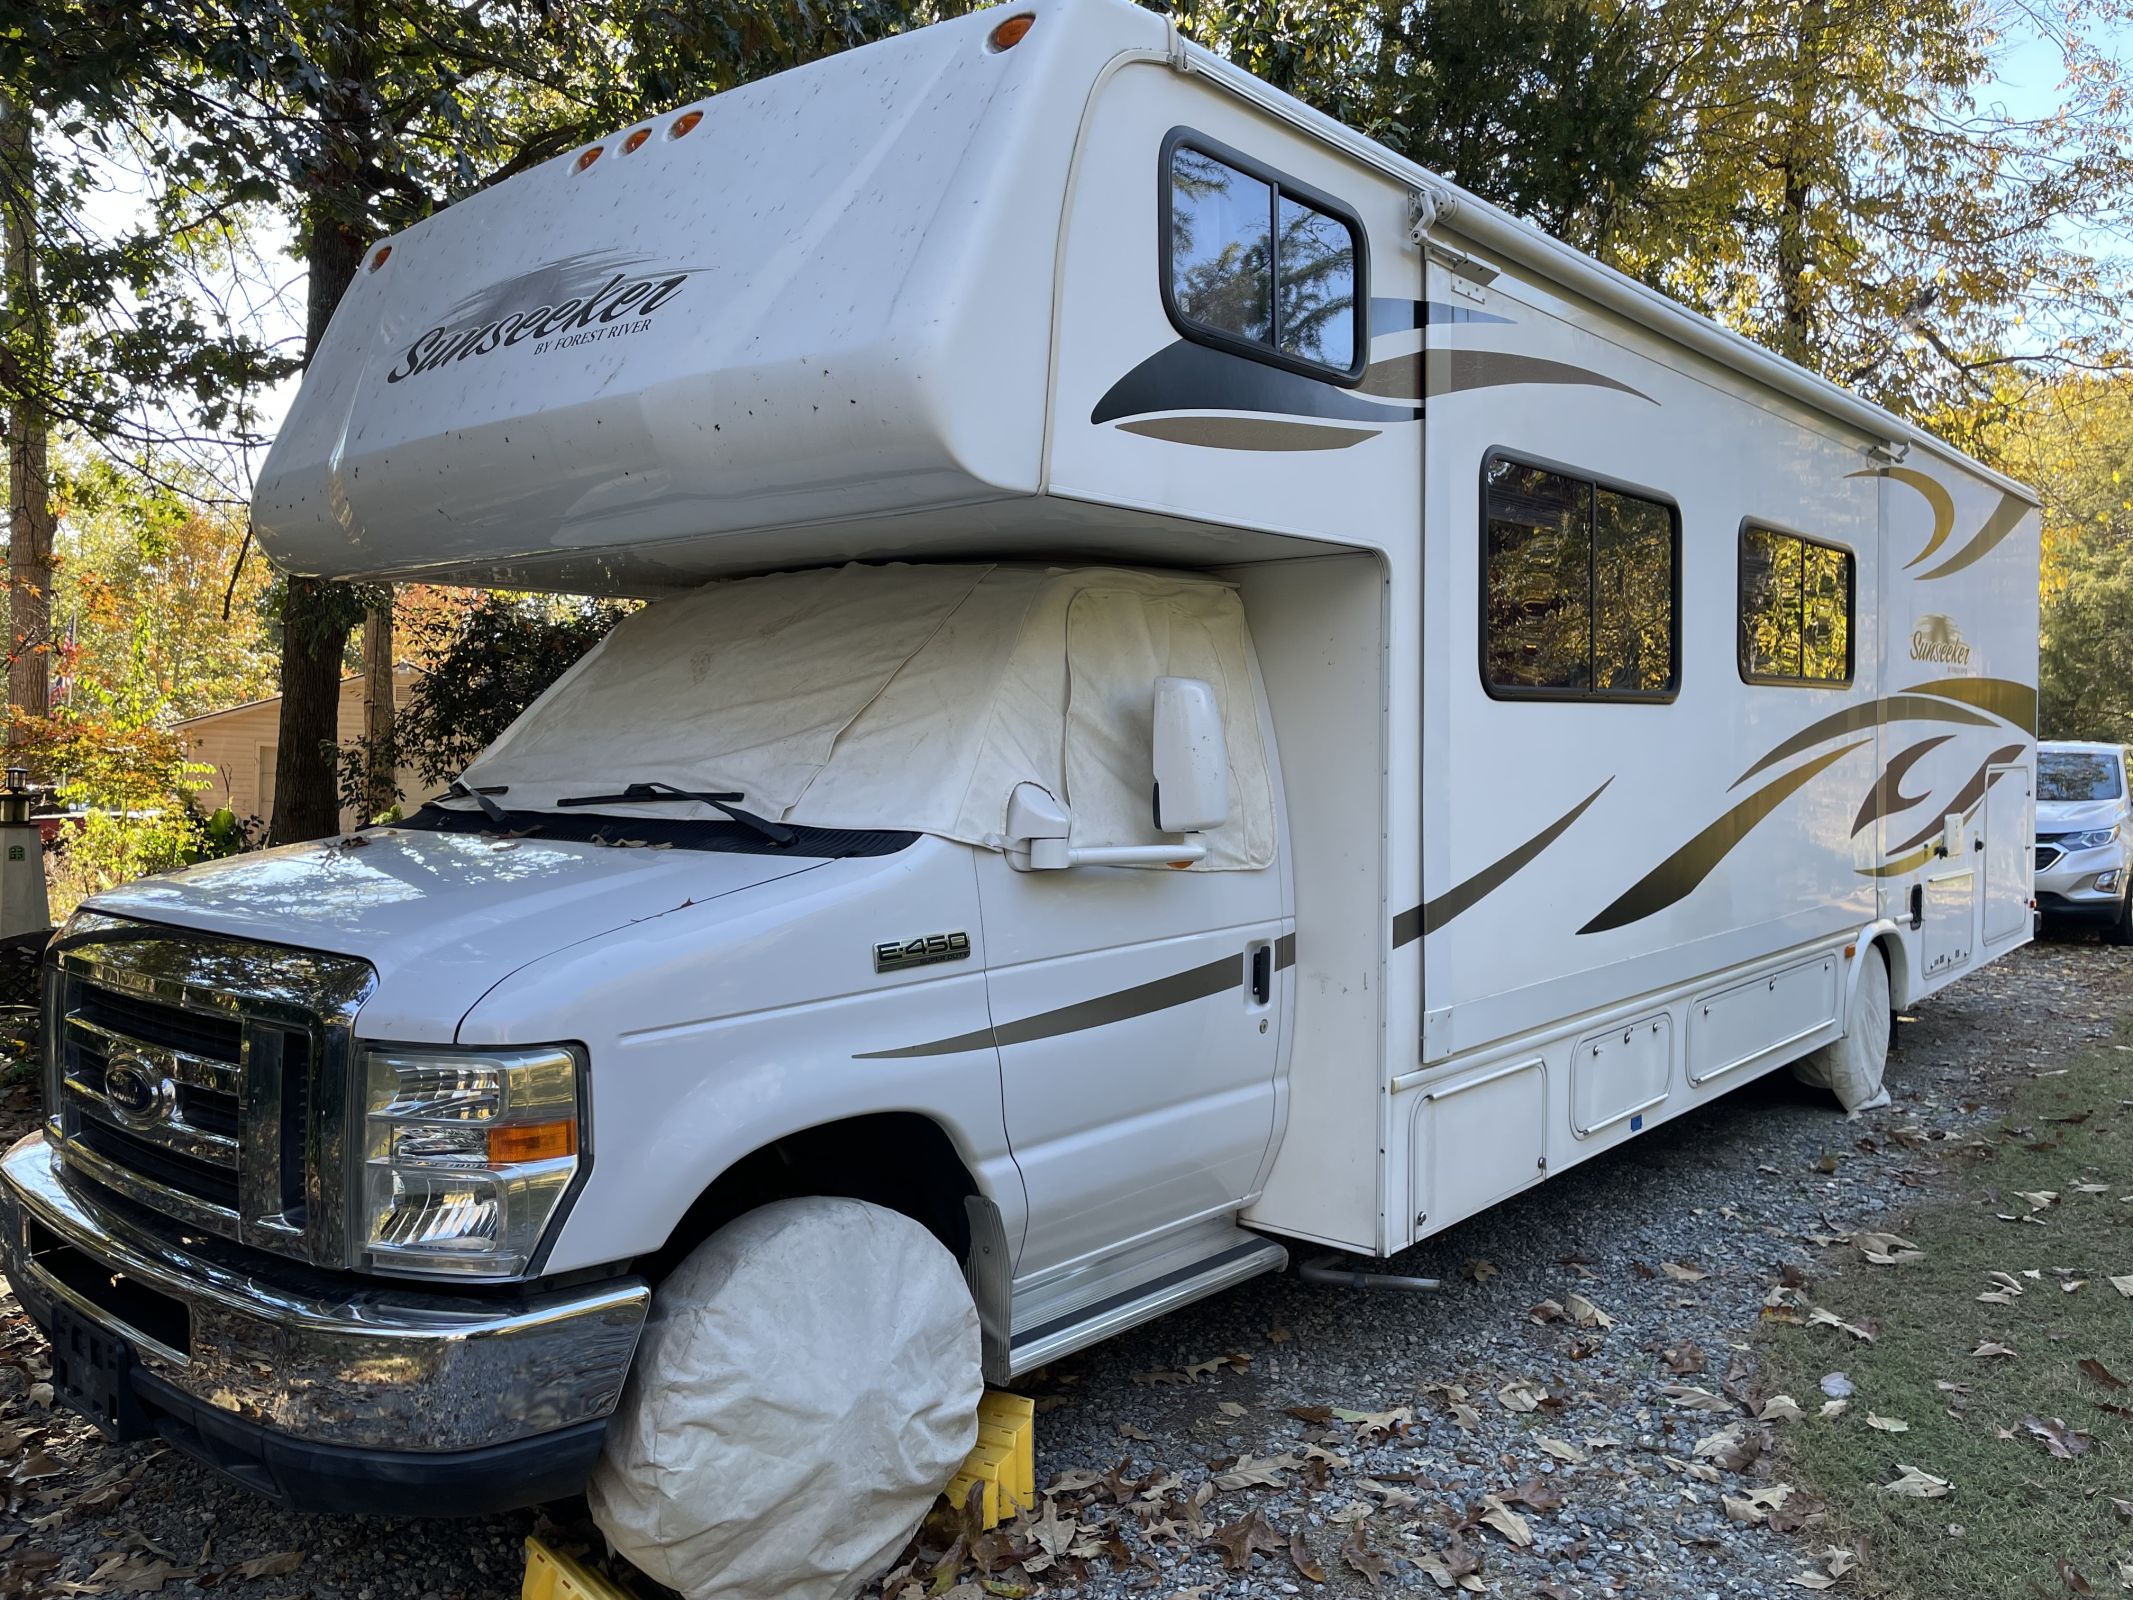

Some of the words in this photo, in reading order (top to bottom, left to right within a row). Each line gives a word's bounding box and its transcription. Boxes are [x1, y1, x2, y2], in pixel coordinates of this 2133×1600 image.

[387, 273, 688, 384] Sunseeker
[534, 341, 553, 356] BY
[554, 327, 609, 351] FOREST
[608, 318, 652, 339] RIVER
[1909, 630, 1970, 666] Sunseeker
[877, 931, 970, 961] E-450
